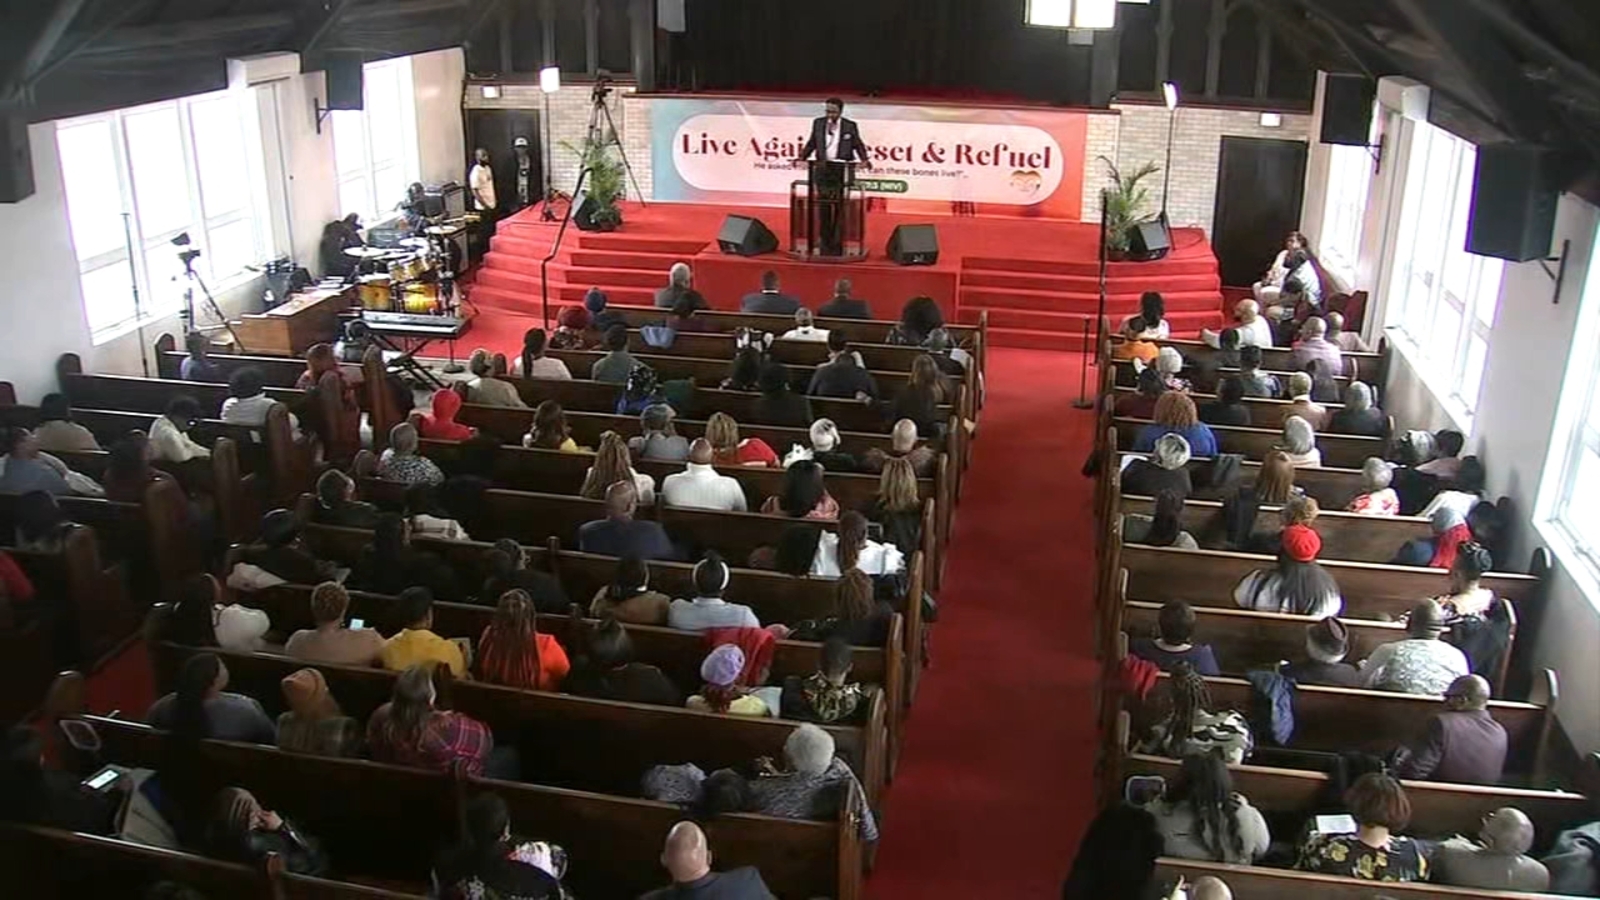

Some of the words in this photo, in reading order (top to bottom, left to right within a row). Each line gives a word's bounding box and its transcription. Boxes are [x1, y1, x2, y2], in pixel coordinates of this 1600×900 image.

[683, 132, 738, 155] Live
[749, 135, 806, 162] Agai
[921, 142, 946, 164] &
[955, 143, 1051, 169] Refuel
